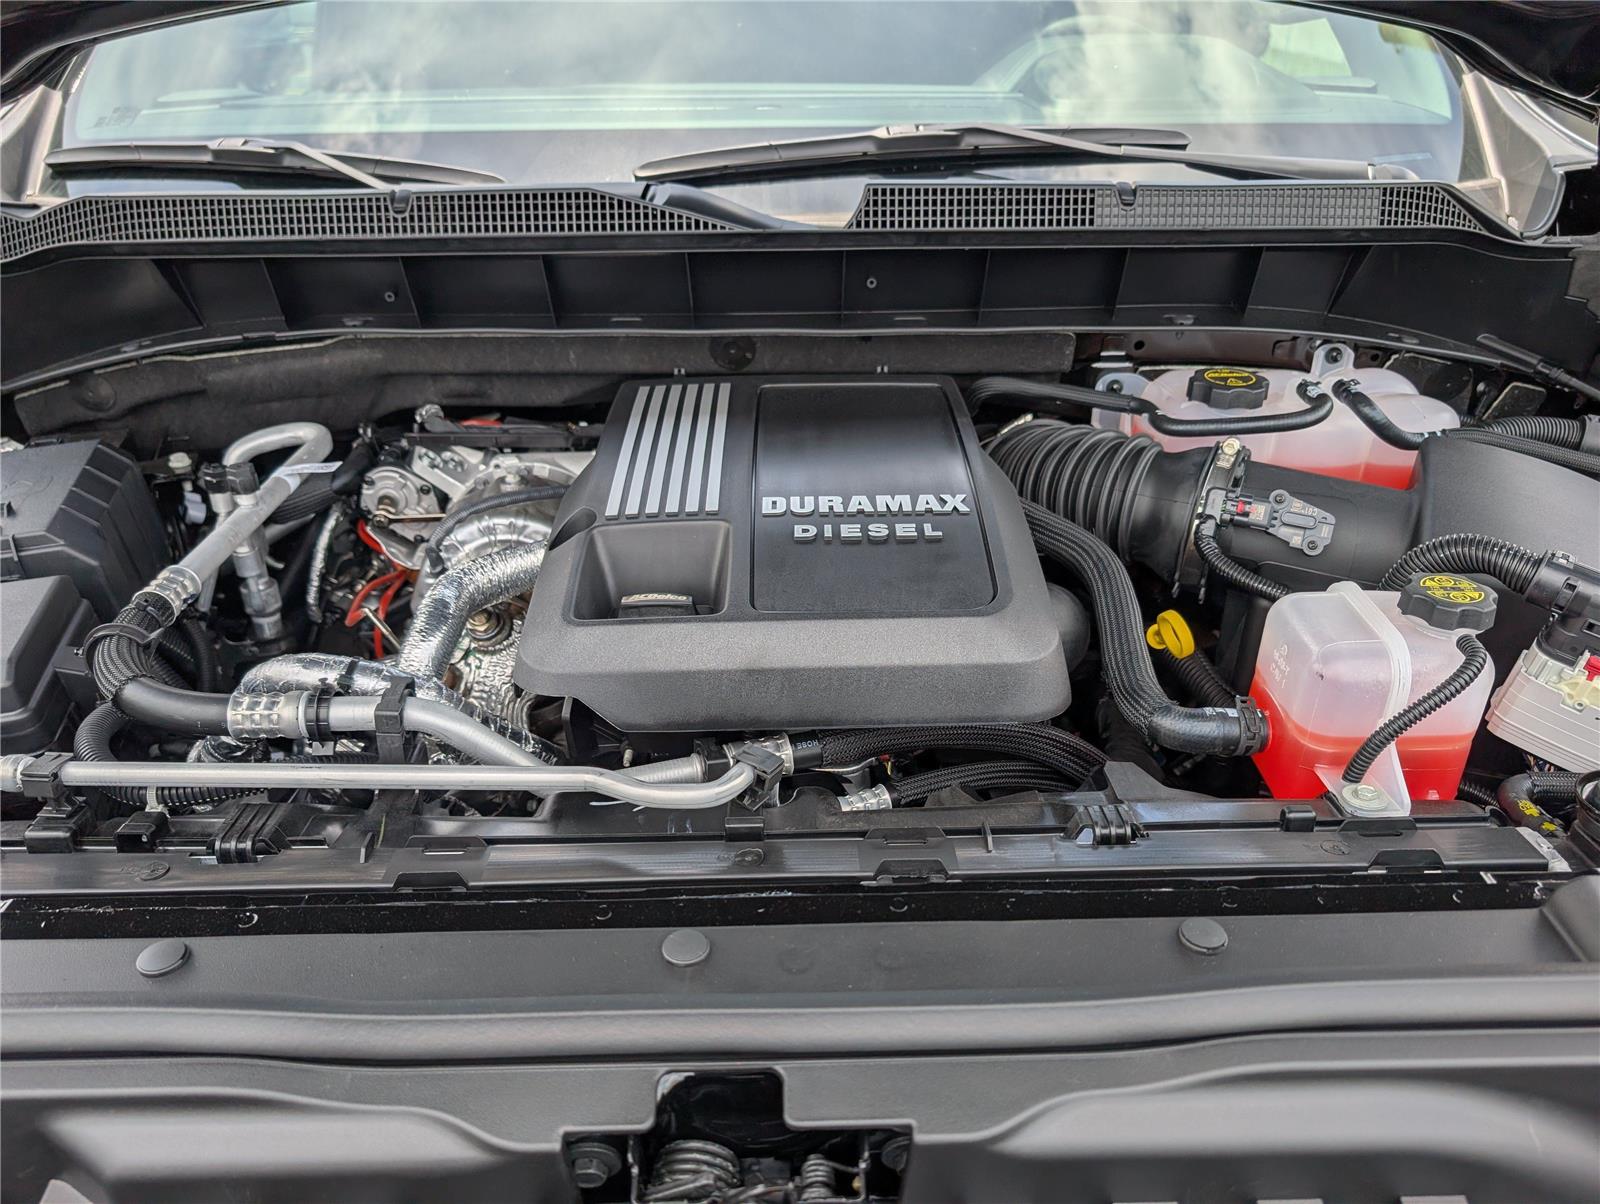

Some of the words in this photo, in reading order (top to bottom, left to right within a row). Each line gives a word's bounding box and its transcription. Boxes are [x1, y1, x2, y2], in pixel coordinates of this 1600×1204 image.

[762, 494, 970, 515] DURAMAX
[793, 523, 943, 541] DIESEL
[796, 739, 819, 750] HOSE
